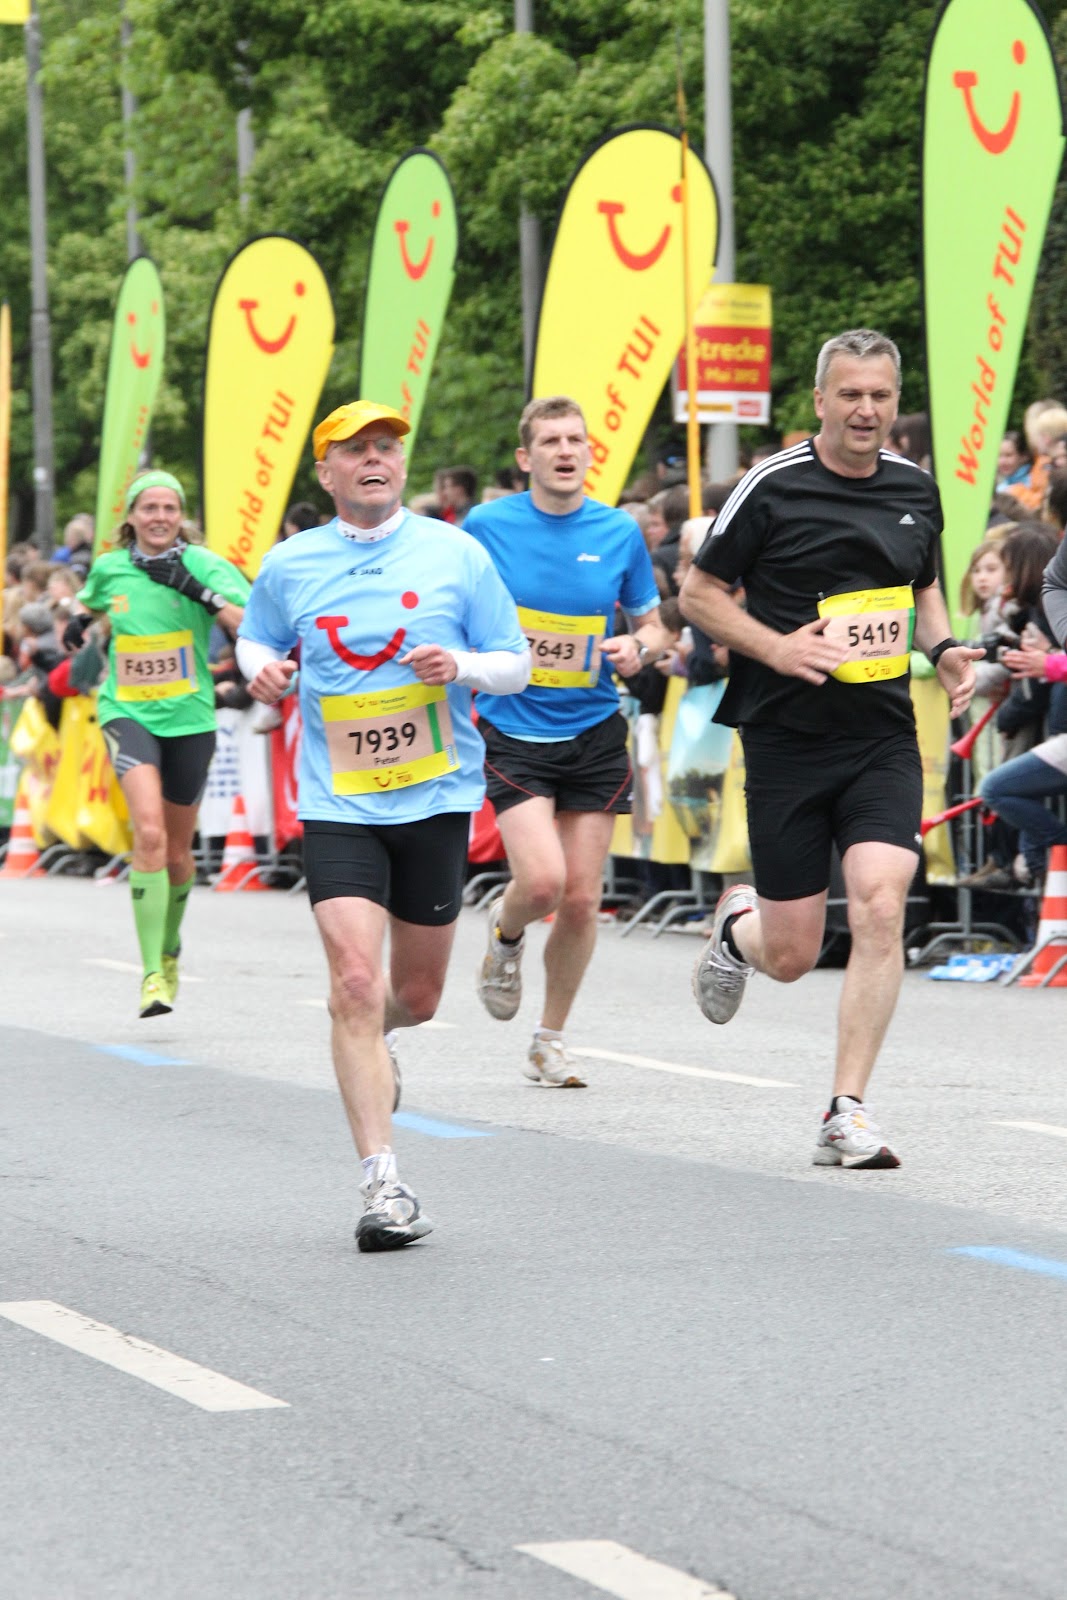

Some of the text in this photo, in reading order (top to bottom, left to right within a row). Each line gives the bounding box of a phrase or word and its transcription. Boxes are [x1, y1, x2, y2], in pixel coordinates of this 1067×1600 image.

[406, 318, 431, 376] TUI
[682, 336, 767, 363] trecke
[955, 205, 1027, 487] World of TUI
[604, 382, 628, 432] of
[617, 315, 661, 380] TUI
[227, 389, 295, 567] World of TUI
[526, 636, 575, 660] 7643
[848, 621, 900, 648] 5419
[125, 657, 177, 676] F4333
[348, 722, 416, 755] 7939
[374, 755, 401, 766] Peter
